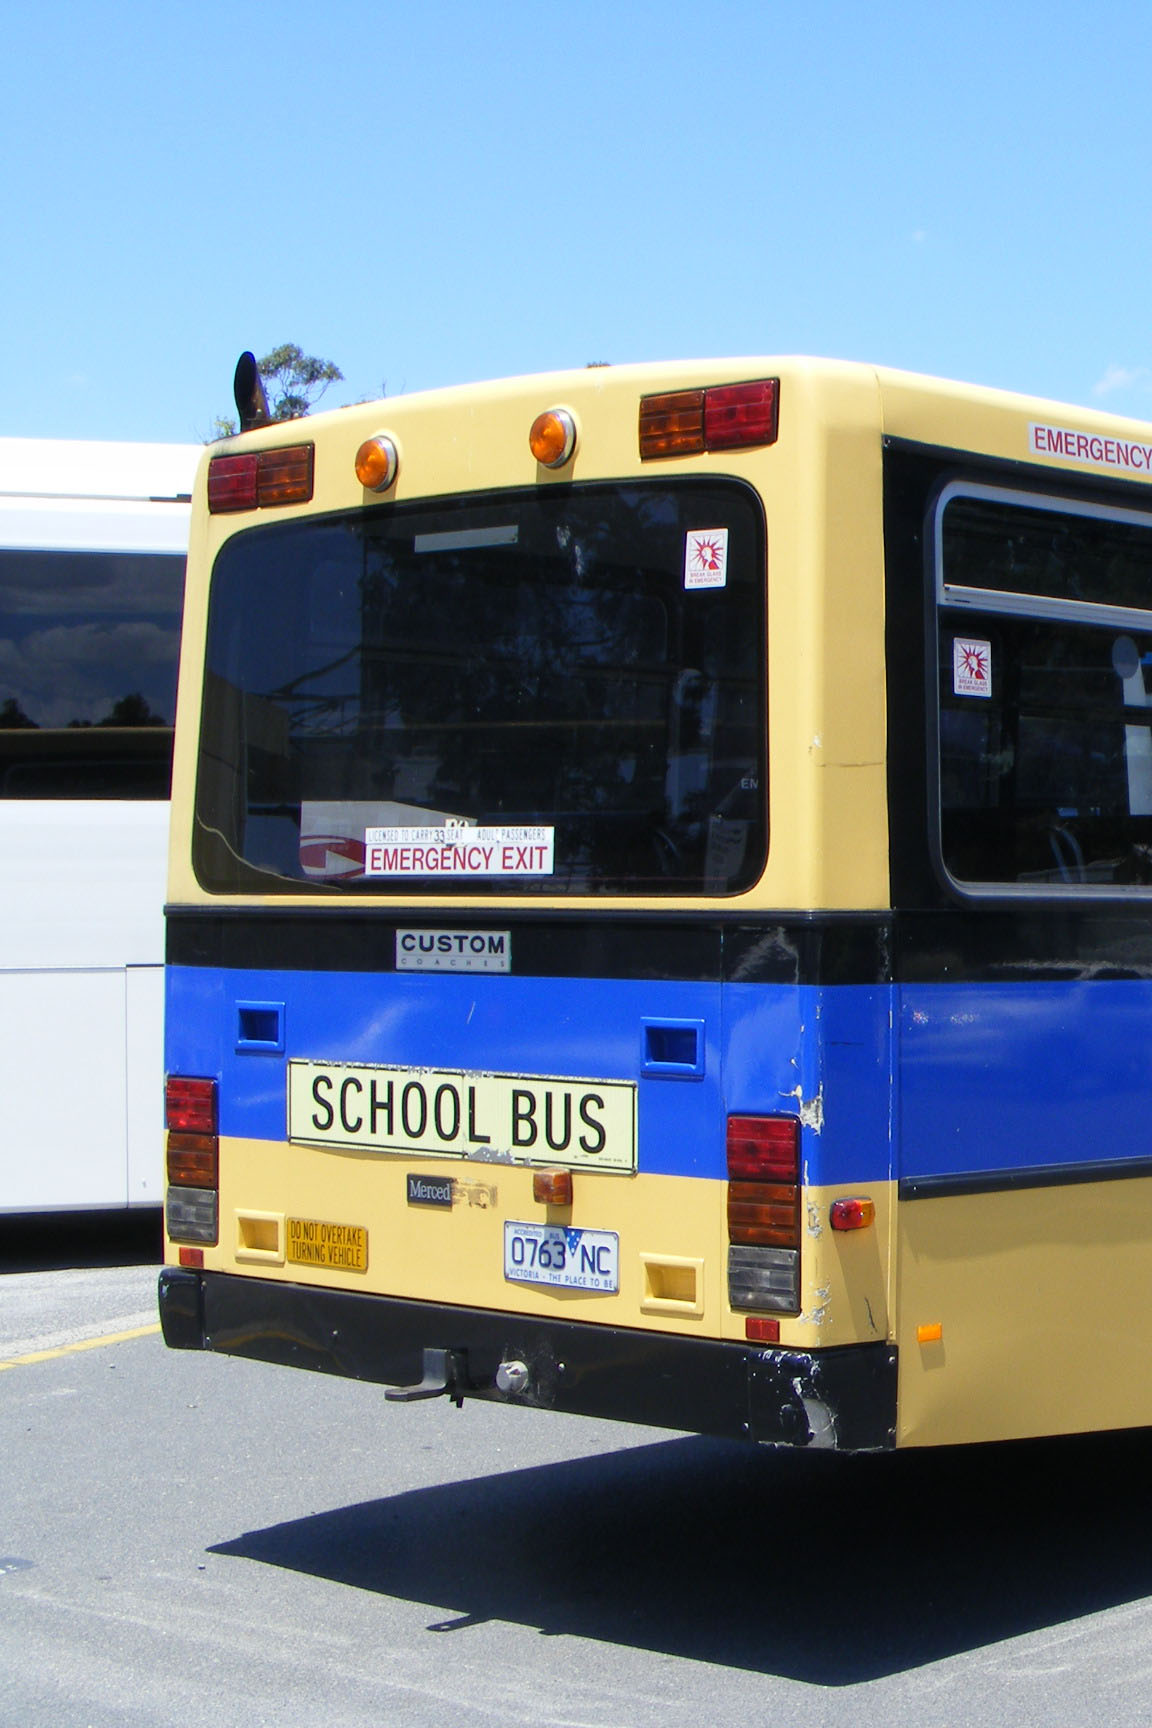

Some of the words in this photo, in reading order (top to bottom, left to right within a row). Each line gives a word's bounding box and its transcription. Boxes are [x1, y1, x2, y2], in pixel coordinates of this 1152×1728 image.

[1034, 426, 1152, 470] EMERGENCY
[368, 829, 400, 842] LICENSED
[401, 829, 410, 842] TO
[411, 829, 433, 841] CARRY
[433, 829, 445, 843] 33
[447, 828, 464, 842] SEAT
[501, 828, 546, 841] PASSENGERS
[370, 847, 494, 871] EMERGENCY
[501, 846, 548, 870] EXIT
[401, 933, 505, 954] CUSTOM
[400, 958, 505, 968] COACHES
[312, 1074, 491, 1144] SCHOOL
[512, 1089, 606, 1154] BUS
[409, 1180, 451, 1201] Merced
[290, 1220, 302, 1239] DO
[303, 1222, 319, 1241] NOT
[320, 1224, 363, 1248] OVERTAKE
[291, 1240, 326, 1263] TURNING
[327, 1245, 361, 1267] VEHICLE
[511, 1236, 566, 1269] 0763
[581, 1243, 611, 1275] NC
[509, 1267, 539, 1279] VICTORIA
[549, 1273, 561, 1282] THE
[565, 1275, 587, 1286] PLACE
[590, 1277, 600, 1287] TO
[603, 1279, 613, 1289] BE
